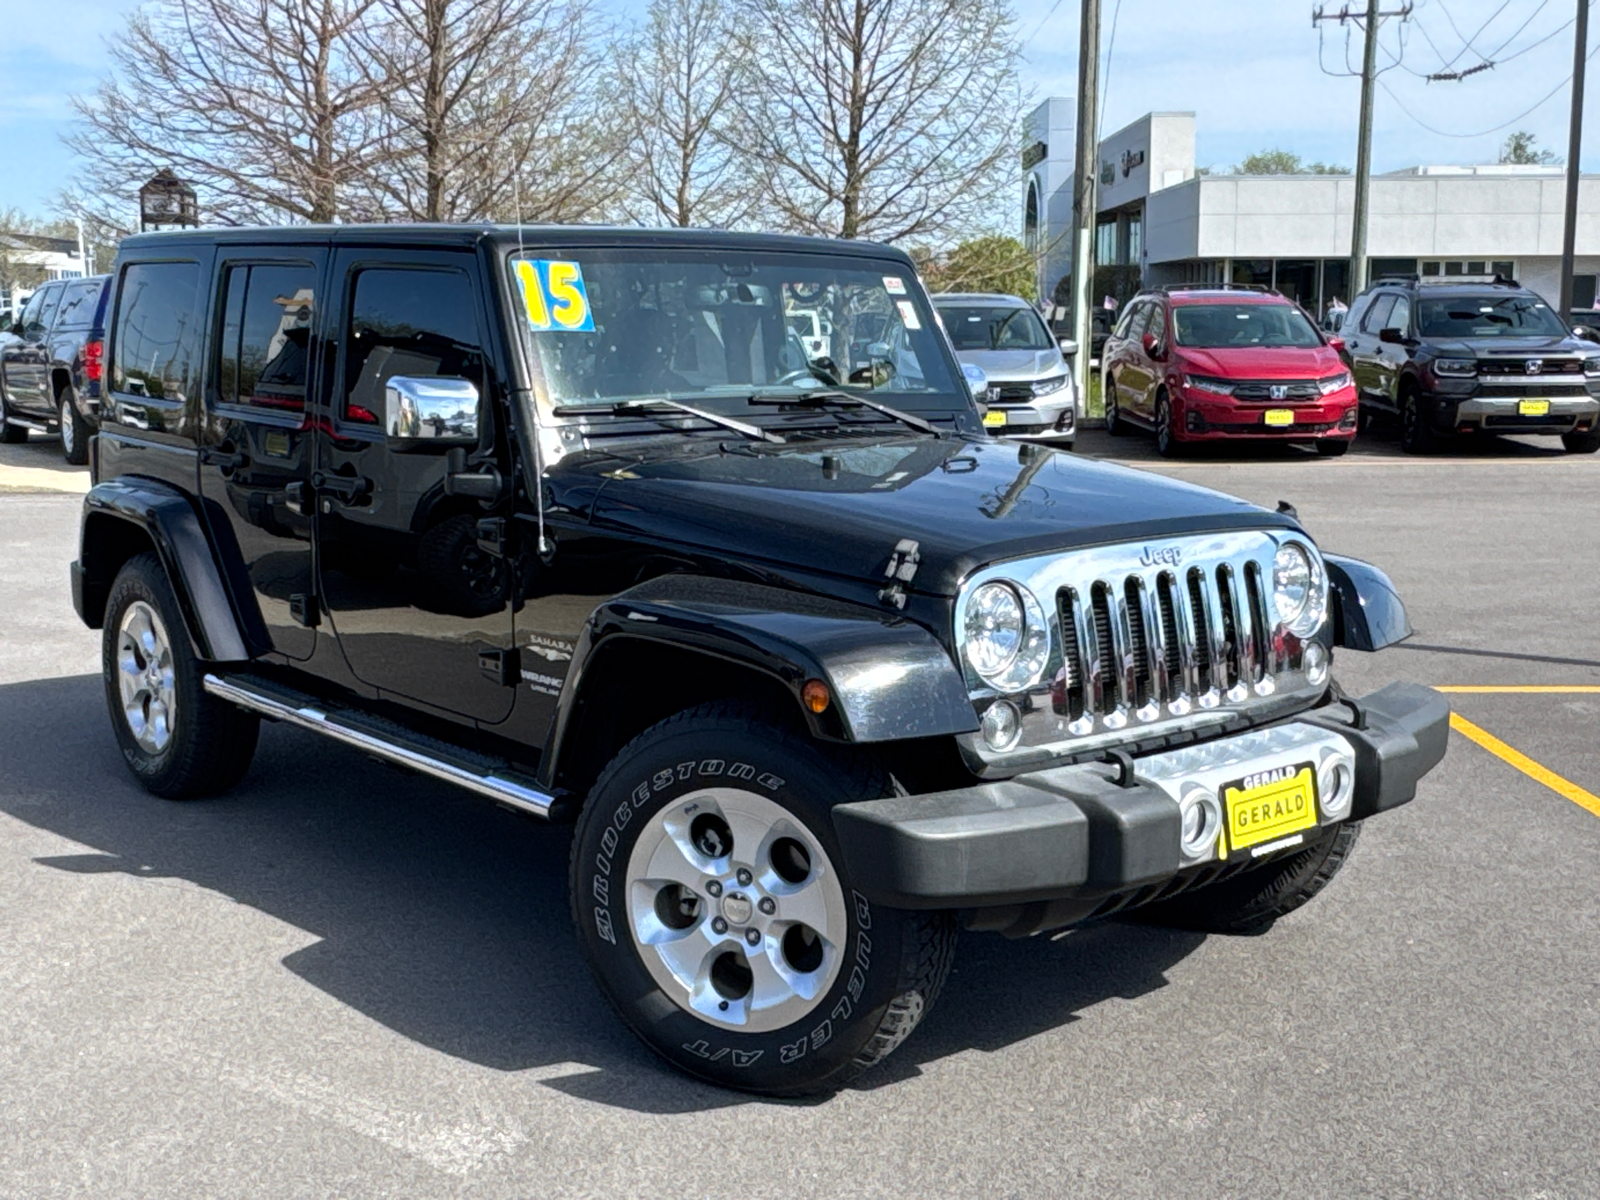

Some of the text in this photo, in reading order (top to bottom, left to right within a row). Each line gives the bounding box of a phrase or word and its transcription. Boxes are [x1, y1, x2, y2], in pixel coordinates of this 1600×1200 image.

[517, 261, 586, 328] 15
[1139, 546, 1182, 567] Jeep
[531, 635, 573, 651] SAHARA
[521, 670, 562, 687] WRANG
[1243, 766, 1296, 790] GERALD
[1238, 794, 1304, 827] GERALD
[593, 759, 785, 945] BRIDGESTONE
[682, 889, 872, 1067] DUELER A/T
